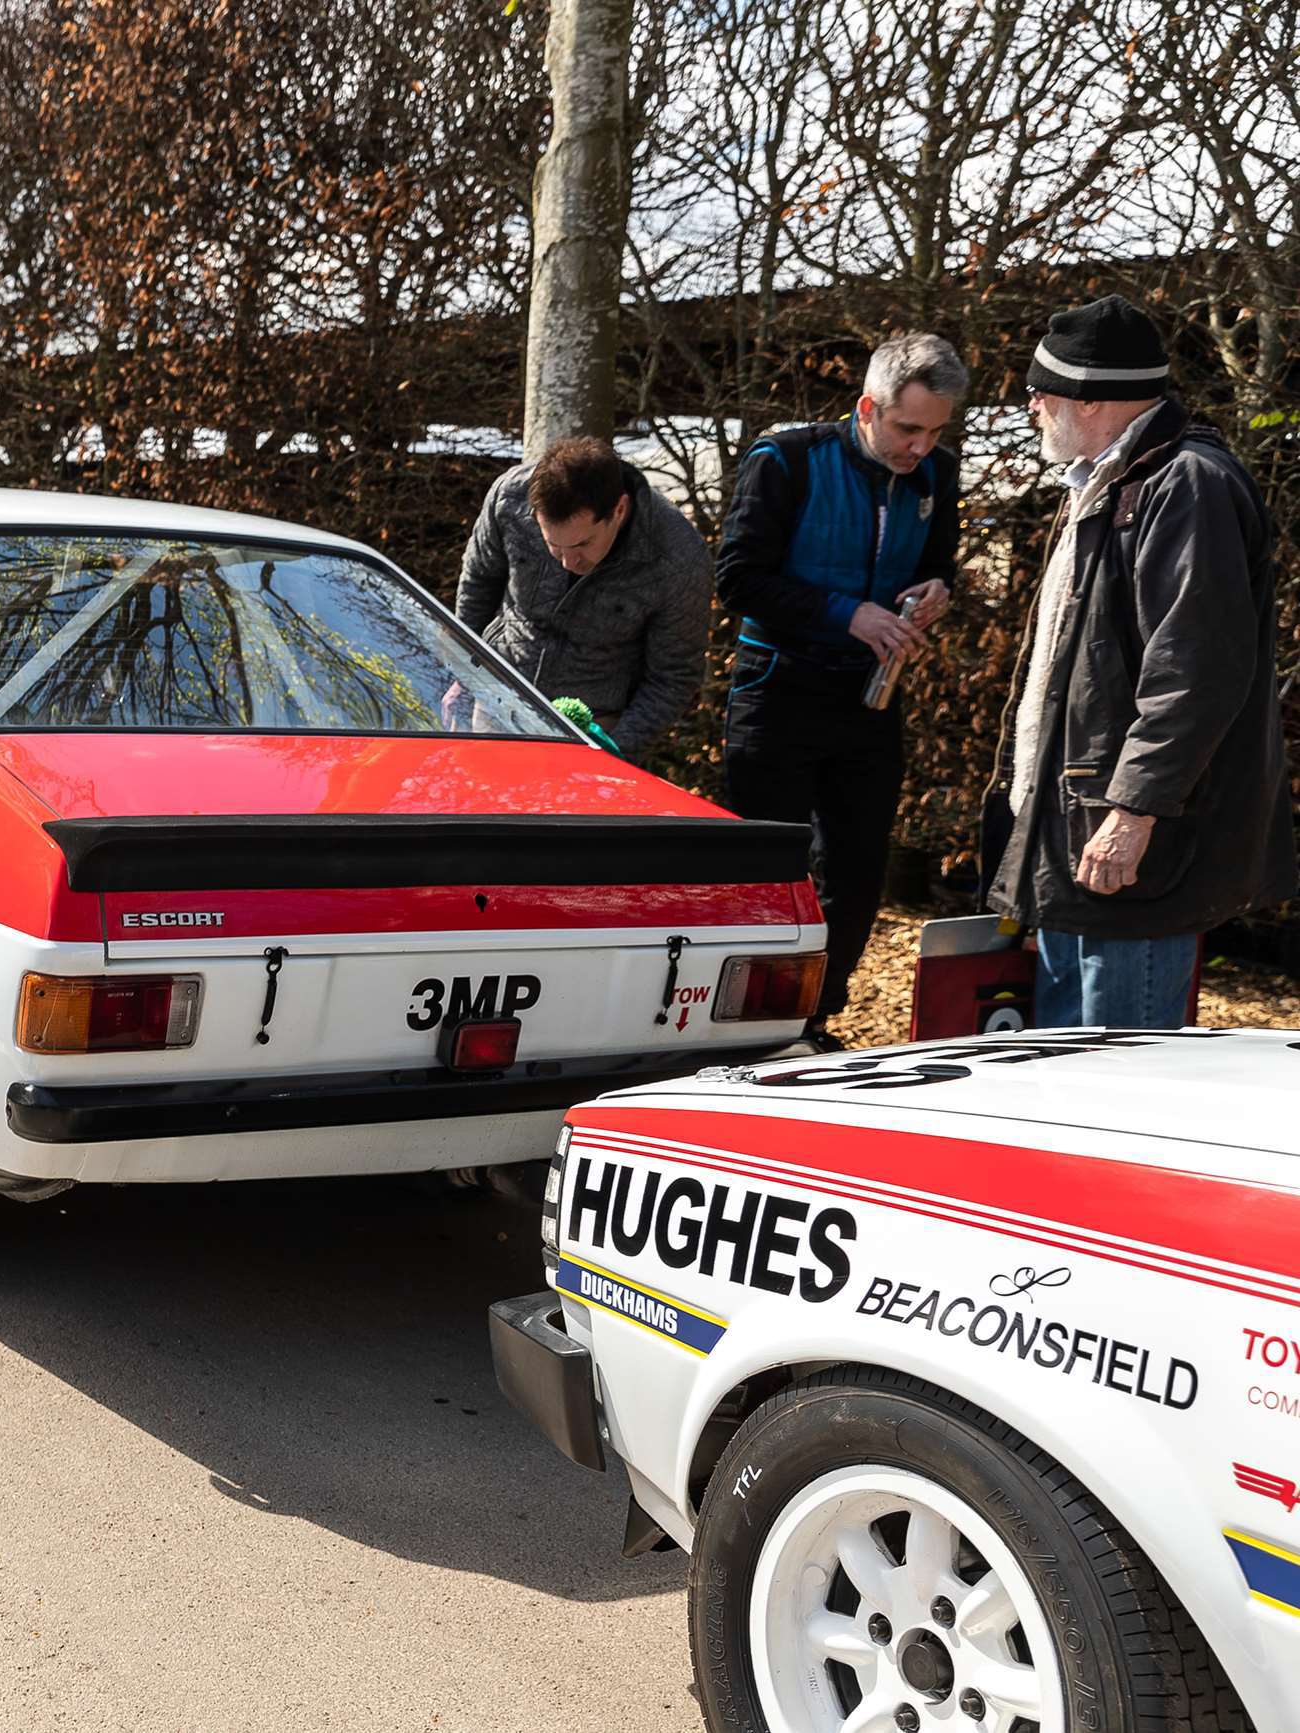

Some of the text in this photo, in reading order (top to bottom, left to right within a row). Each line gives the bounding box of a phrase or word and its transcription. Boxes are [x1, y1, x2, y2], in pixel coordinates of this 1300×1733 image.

[122, 912, 225, 927] ESCORT
[406, 974, 542, 1031] 3MP
[567, 1157, 857, 1304] HUGHES
[580, 1268, 679, 1335] DUCKHAMS
[856, 1277, 1198, 1410] BEACONSFIELD
[1248, 1386, 1300, 1418] COM
[732, 1464, 762, 1499] TFL
